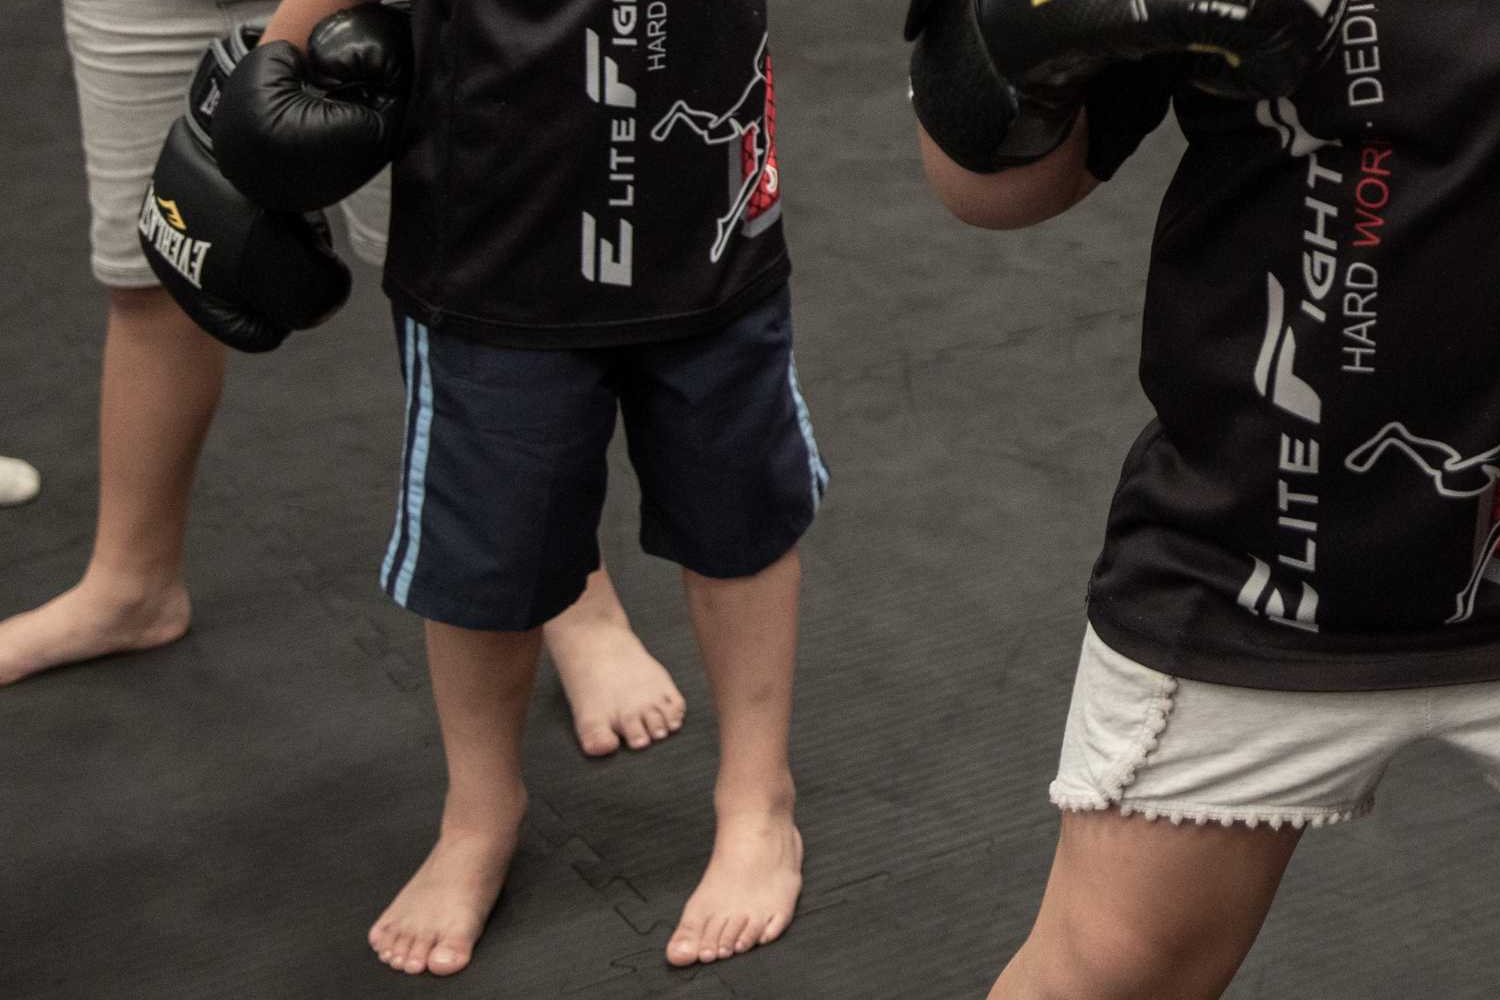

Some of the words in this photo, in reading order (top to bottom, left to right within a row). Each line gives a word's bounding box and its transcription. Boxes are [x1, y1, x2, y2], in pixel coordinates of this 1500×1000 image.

[647, 1, 667, 72] HARD
[581, 116, 637, 287] ELITE
[1352, 146, 1393, 248] WOR
[1254, 152, 1343, 425] FIGHT
[1342, 261, 1379, 373] HARD
[1237, 432, 1320, 634] ELITE
